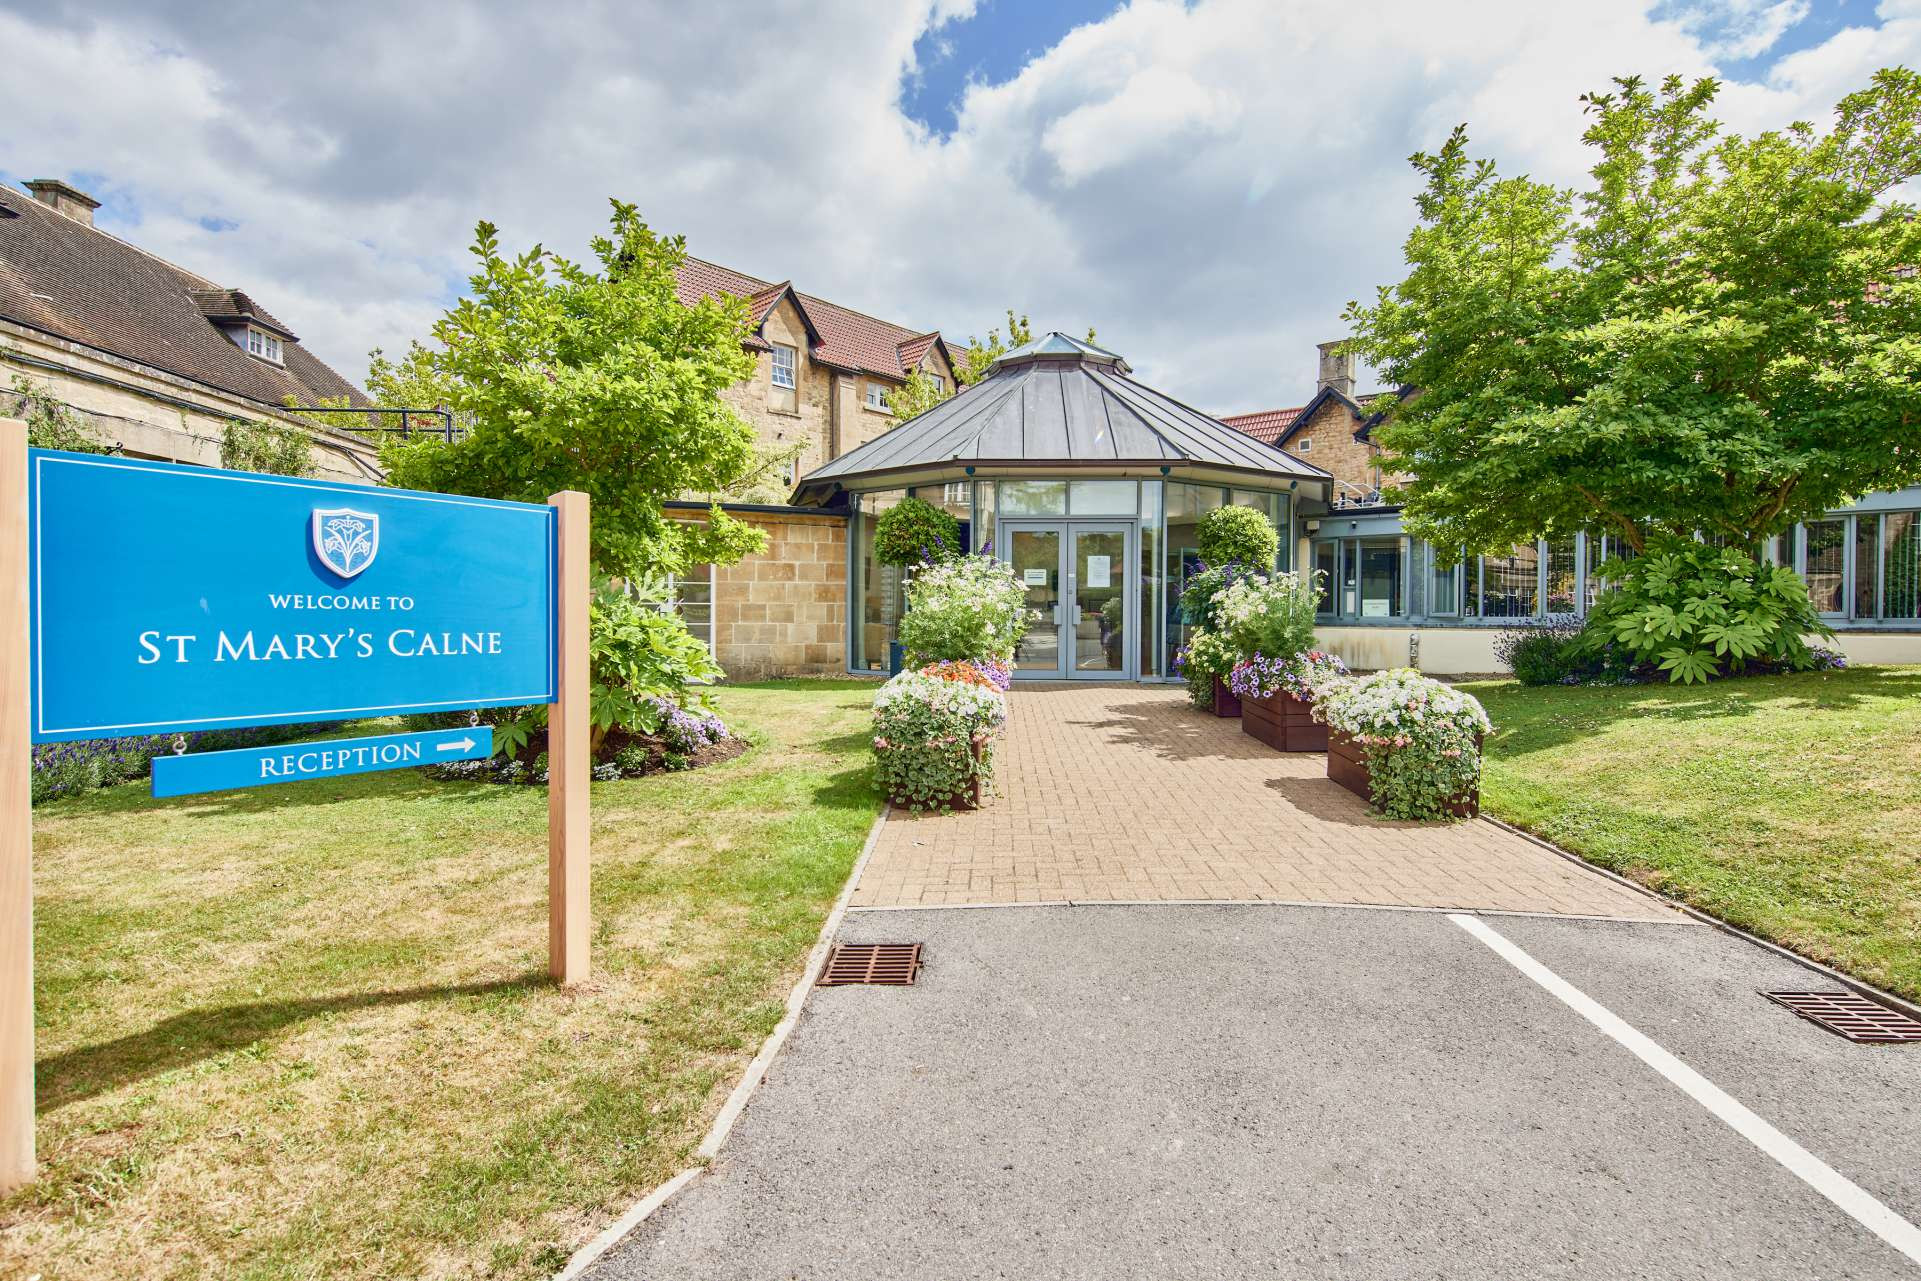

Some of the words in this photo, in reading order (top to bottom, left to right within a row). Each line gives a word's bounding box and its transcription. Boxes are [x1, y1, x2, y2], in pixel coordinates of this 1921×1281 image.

[268, 594, 381, 610] WELCOME
[386, 596, 415, 611] TO
[259, 740, 422, 779] RECEPTION
